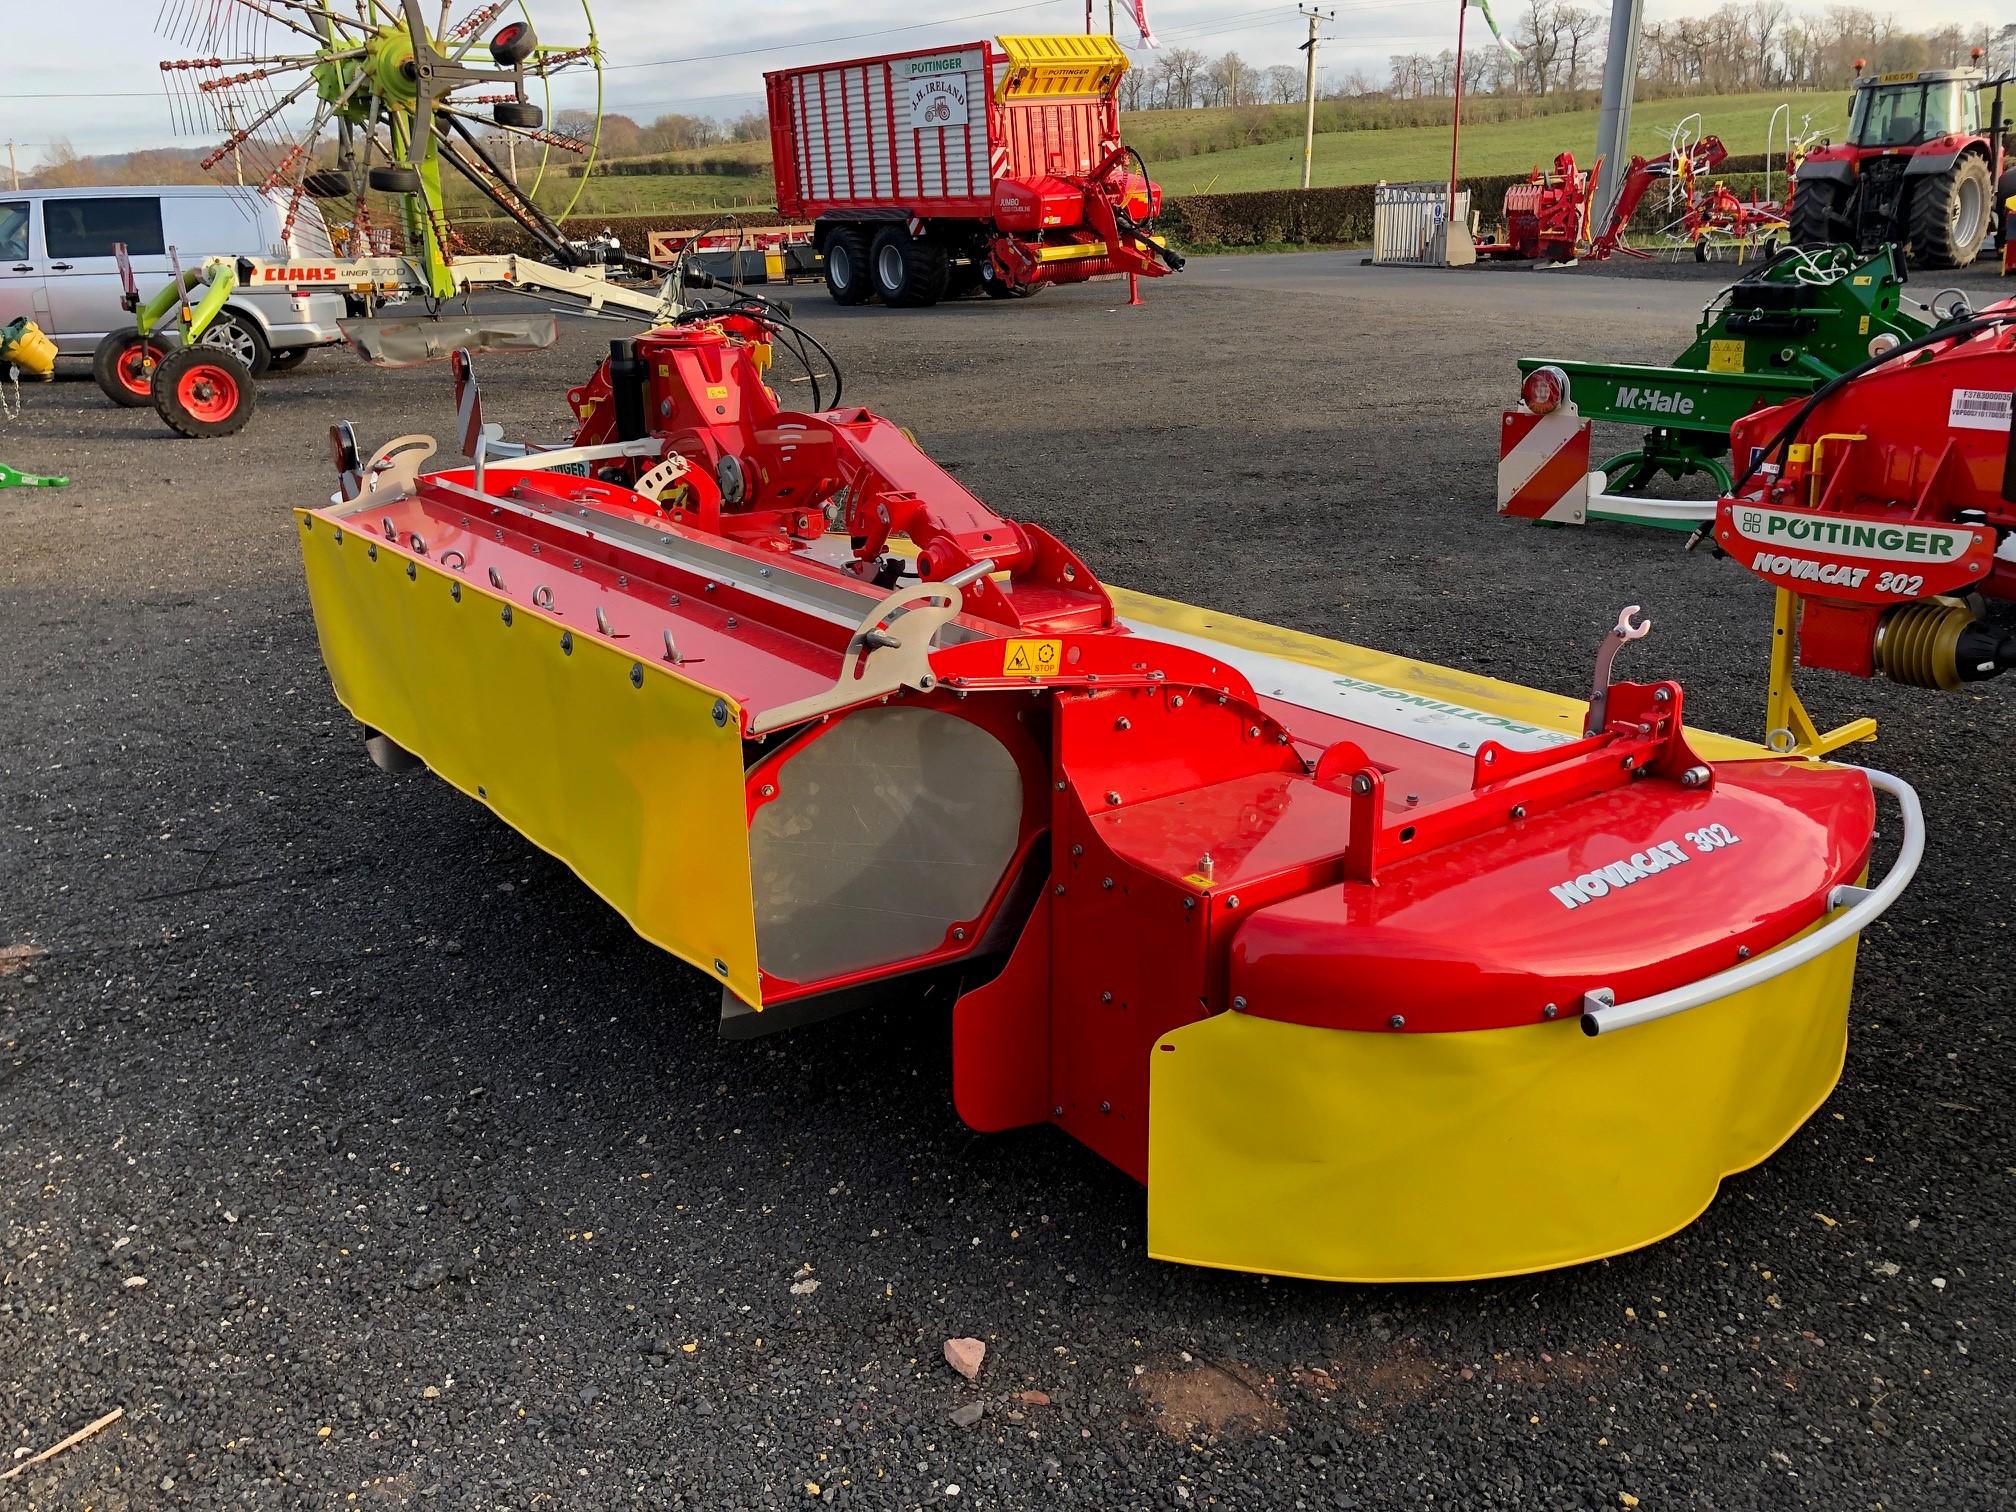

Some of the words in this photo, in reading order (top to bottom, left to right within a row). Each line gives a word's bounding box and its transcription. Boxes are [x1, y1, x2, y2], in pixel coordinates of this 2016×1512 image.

[925, 81, 965, 105] IRELAND
[1000, 198, 1020, 206] JUMBO
[264, 267, 336, 281] CLAAS
[341, 269, 368, 277] LINER
[371, 267, 406, 276] 2700
[1615, 386, 1695, 415] McHale
[1752, 552, 1870, 588] NOVACAT
[1875, 572, 1924, 596] 302
[1035, 664, 1055, 672] STOP
[1549, 840, 1691, 909] NOVACAT
[1685, 823, 1742, 853] 302
